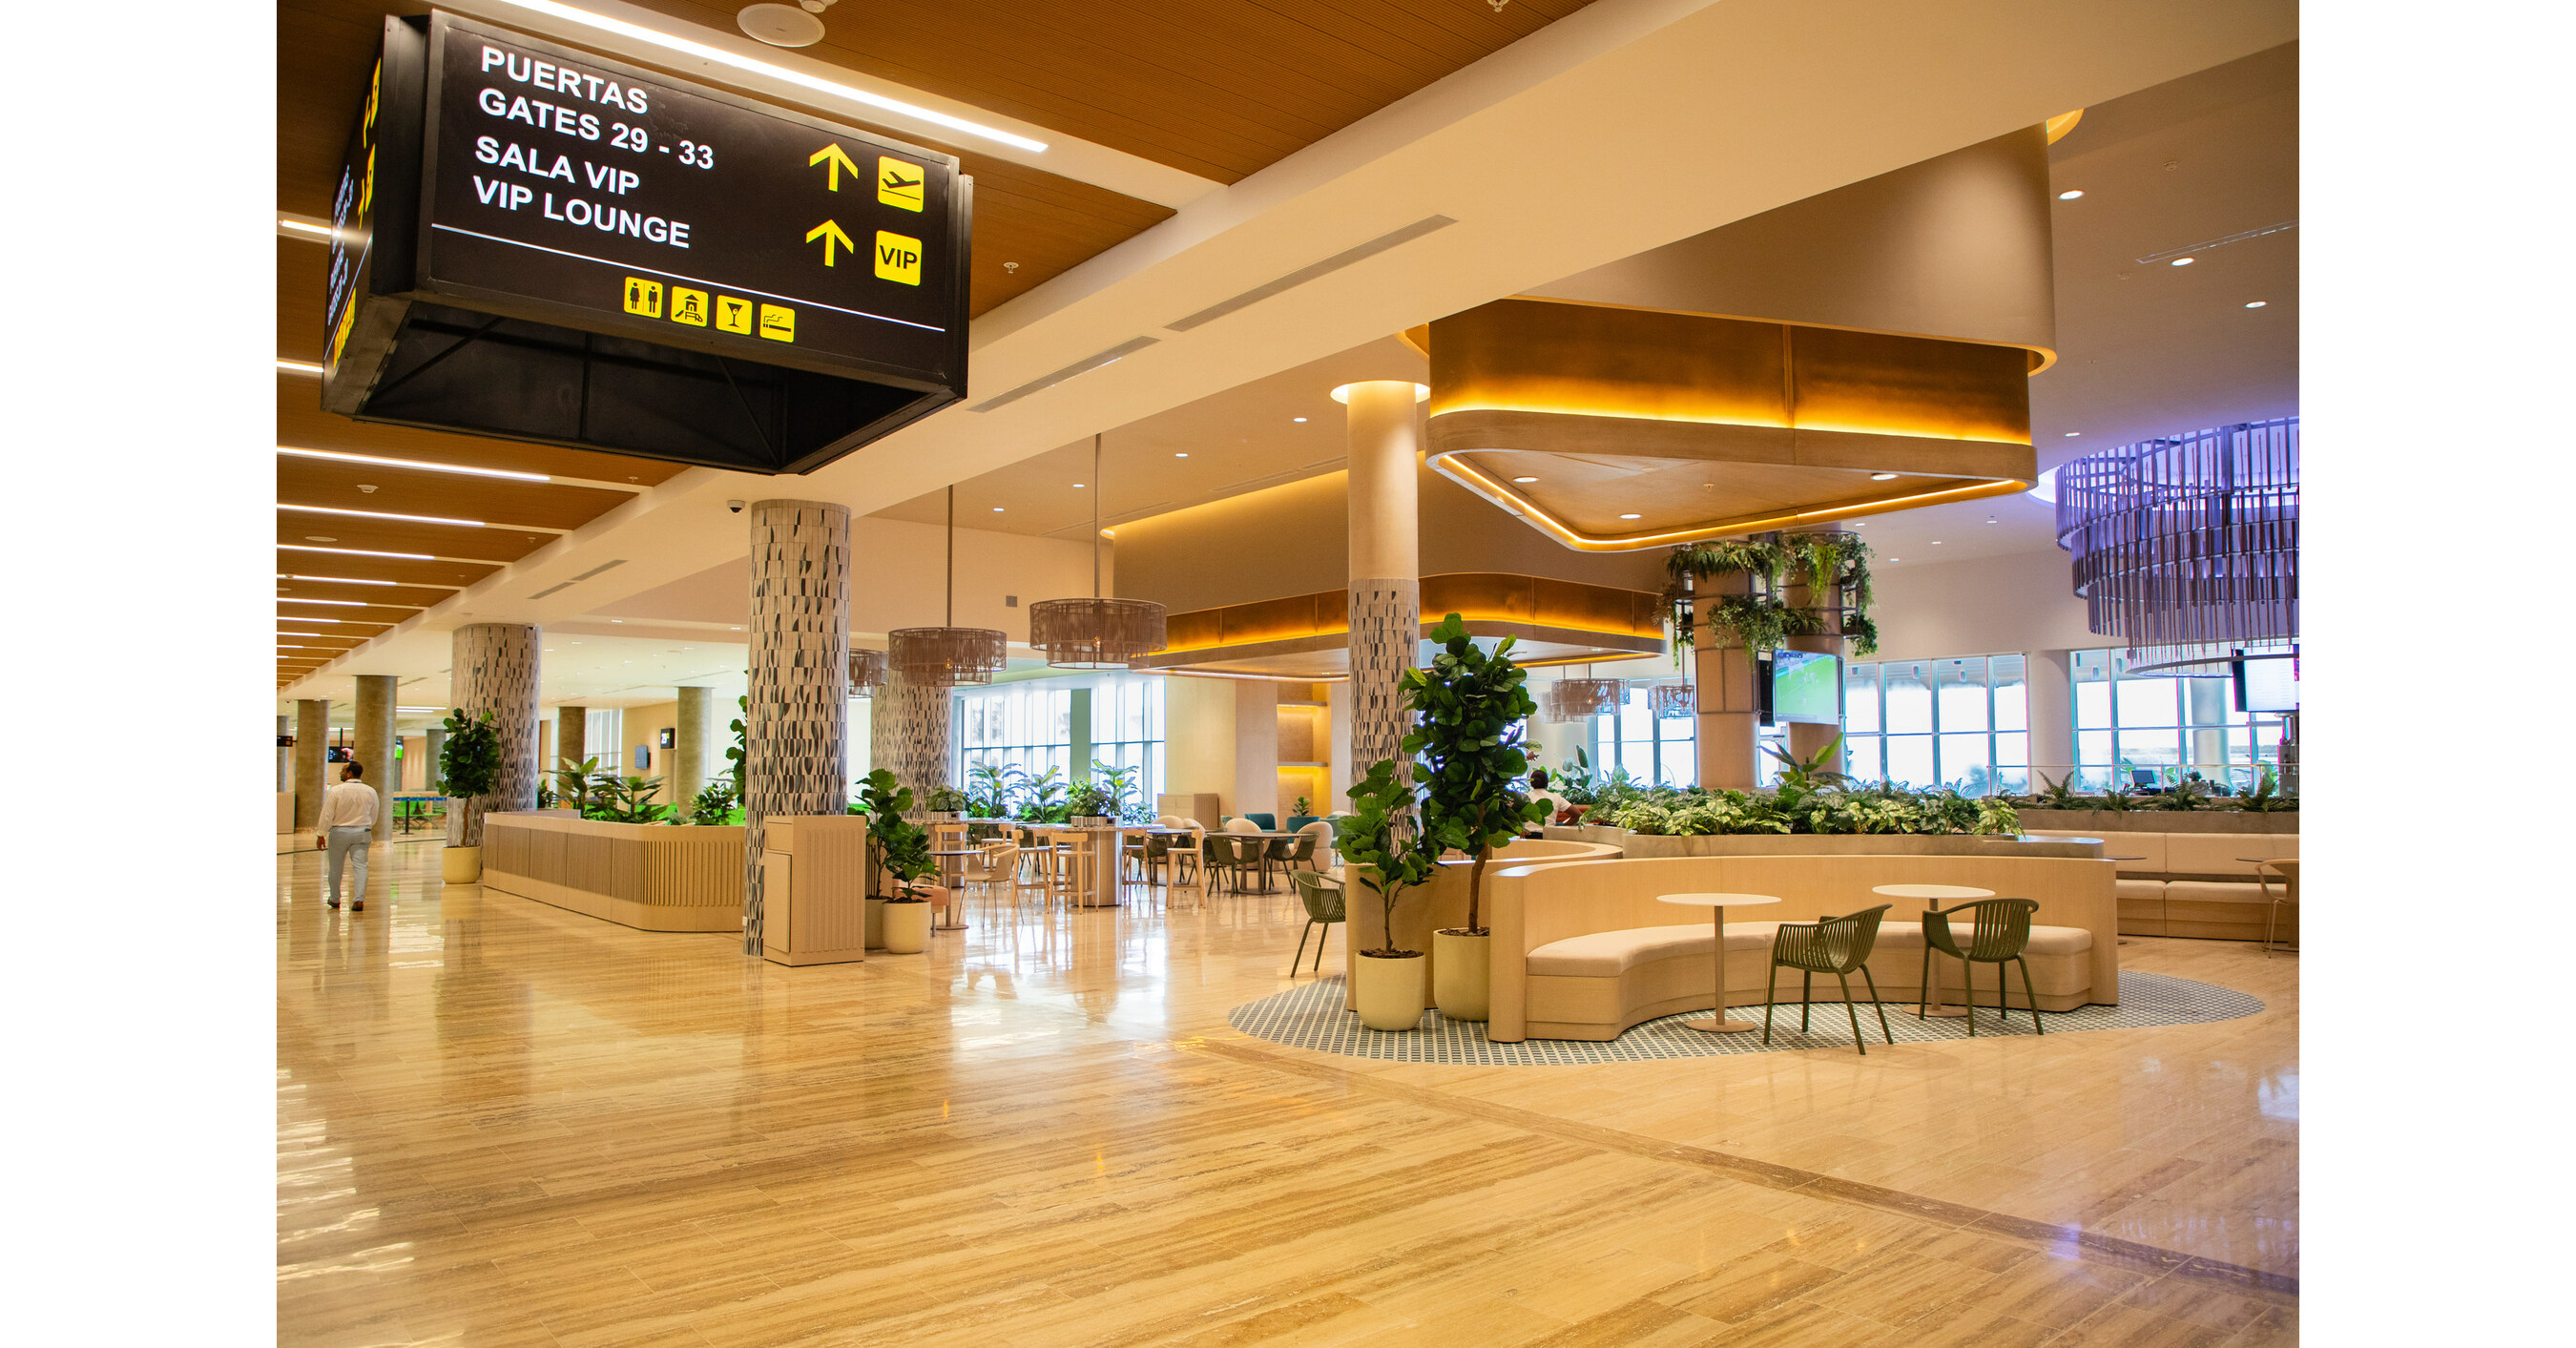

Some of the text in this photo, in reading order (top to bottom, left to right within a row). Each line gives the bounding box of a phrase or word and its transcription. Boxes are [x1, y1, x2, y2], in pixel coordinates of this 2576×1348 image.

[481, 45, 649, 114] PUERTAS
[479, 88, 715, 170] GATES 29 - 33
[475, 135, 640, 196] SALA VIP
[473, 175, 691, 249] VIP LOUNGE
[879, 244, 918, 270] VIP
